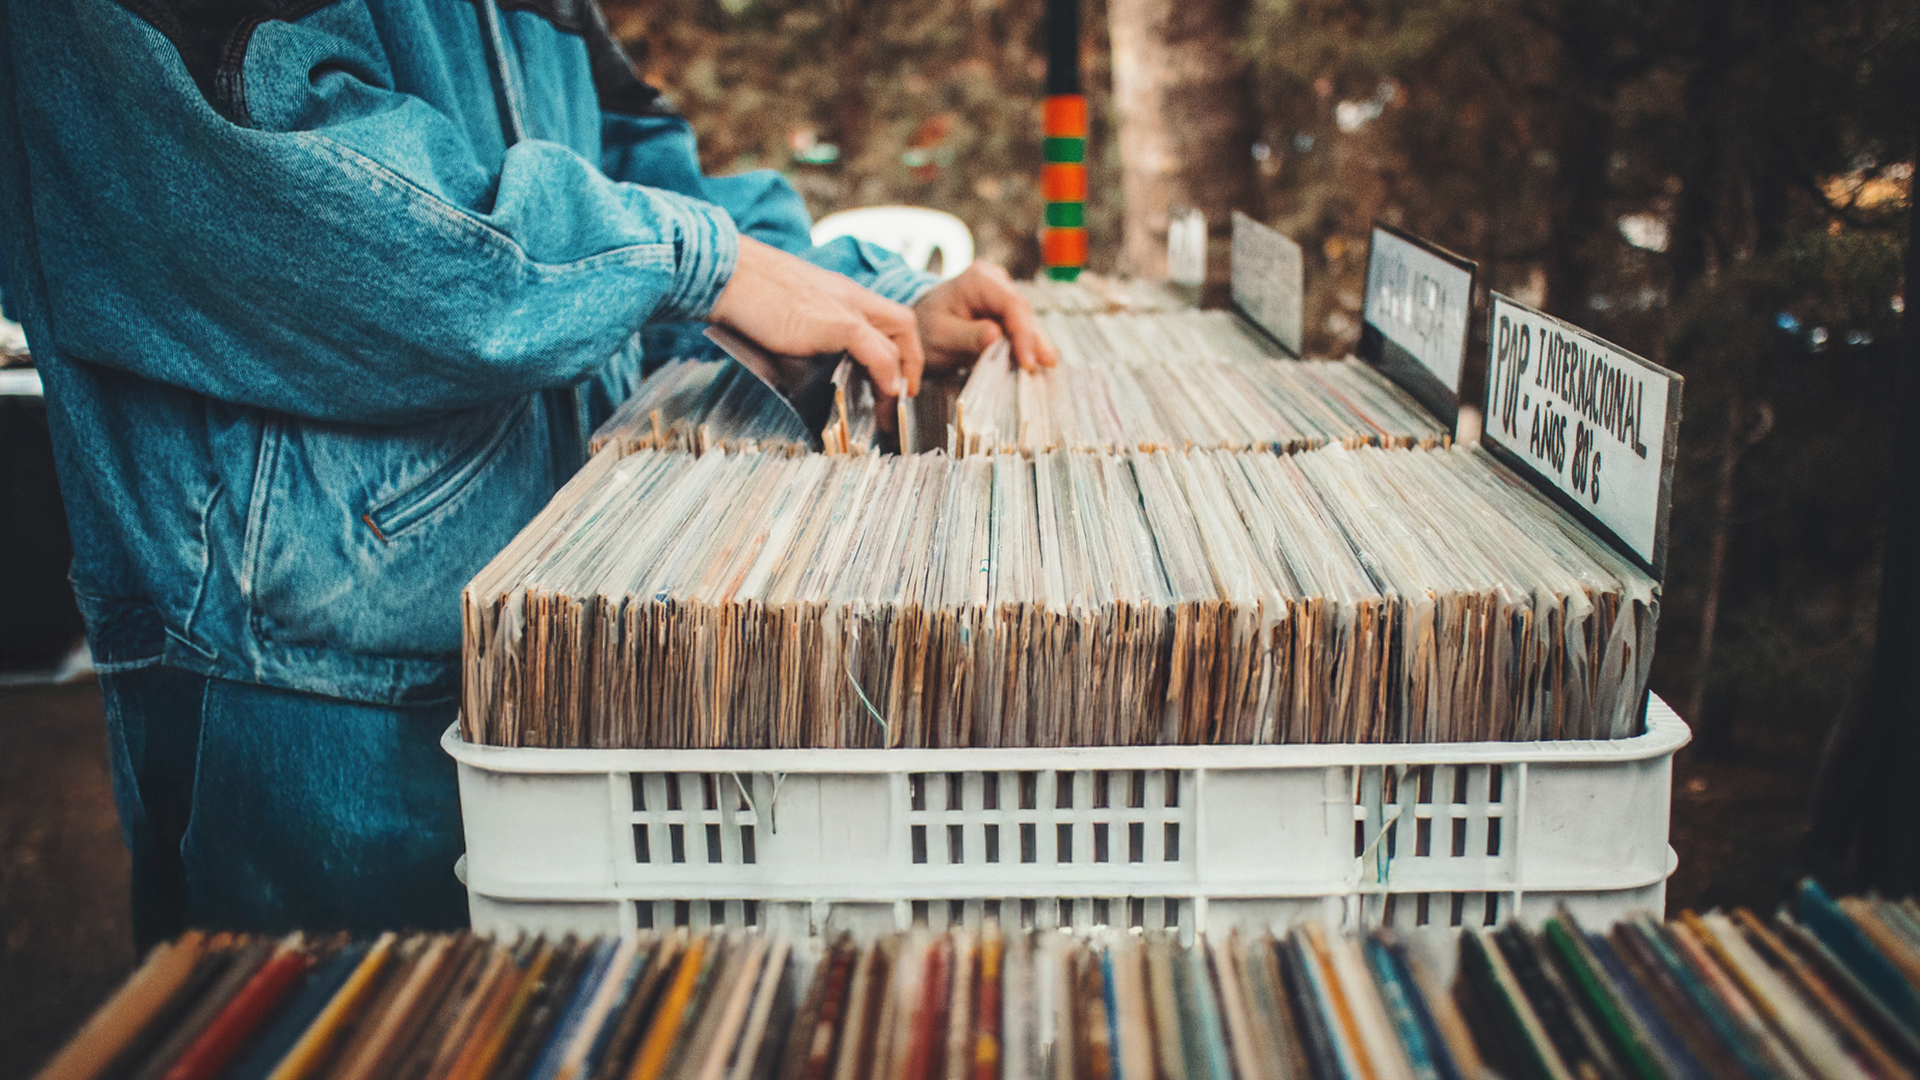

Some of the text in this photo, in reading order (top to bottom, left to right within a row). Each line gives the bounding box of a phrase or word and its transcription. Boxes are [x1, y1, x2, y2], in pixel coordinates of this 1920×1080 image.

[1493, 315, 1647, 460] POP INTERNACIONAL
[1530, 400, 1567, 474] AÑOS
